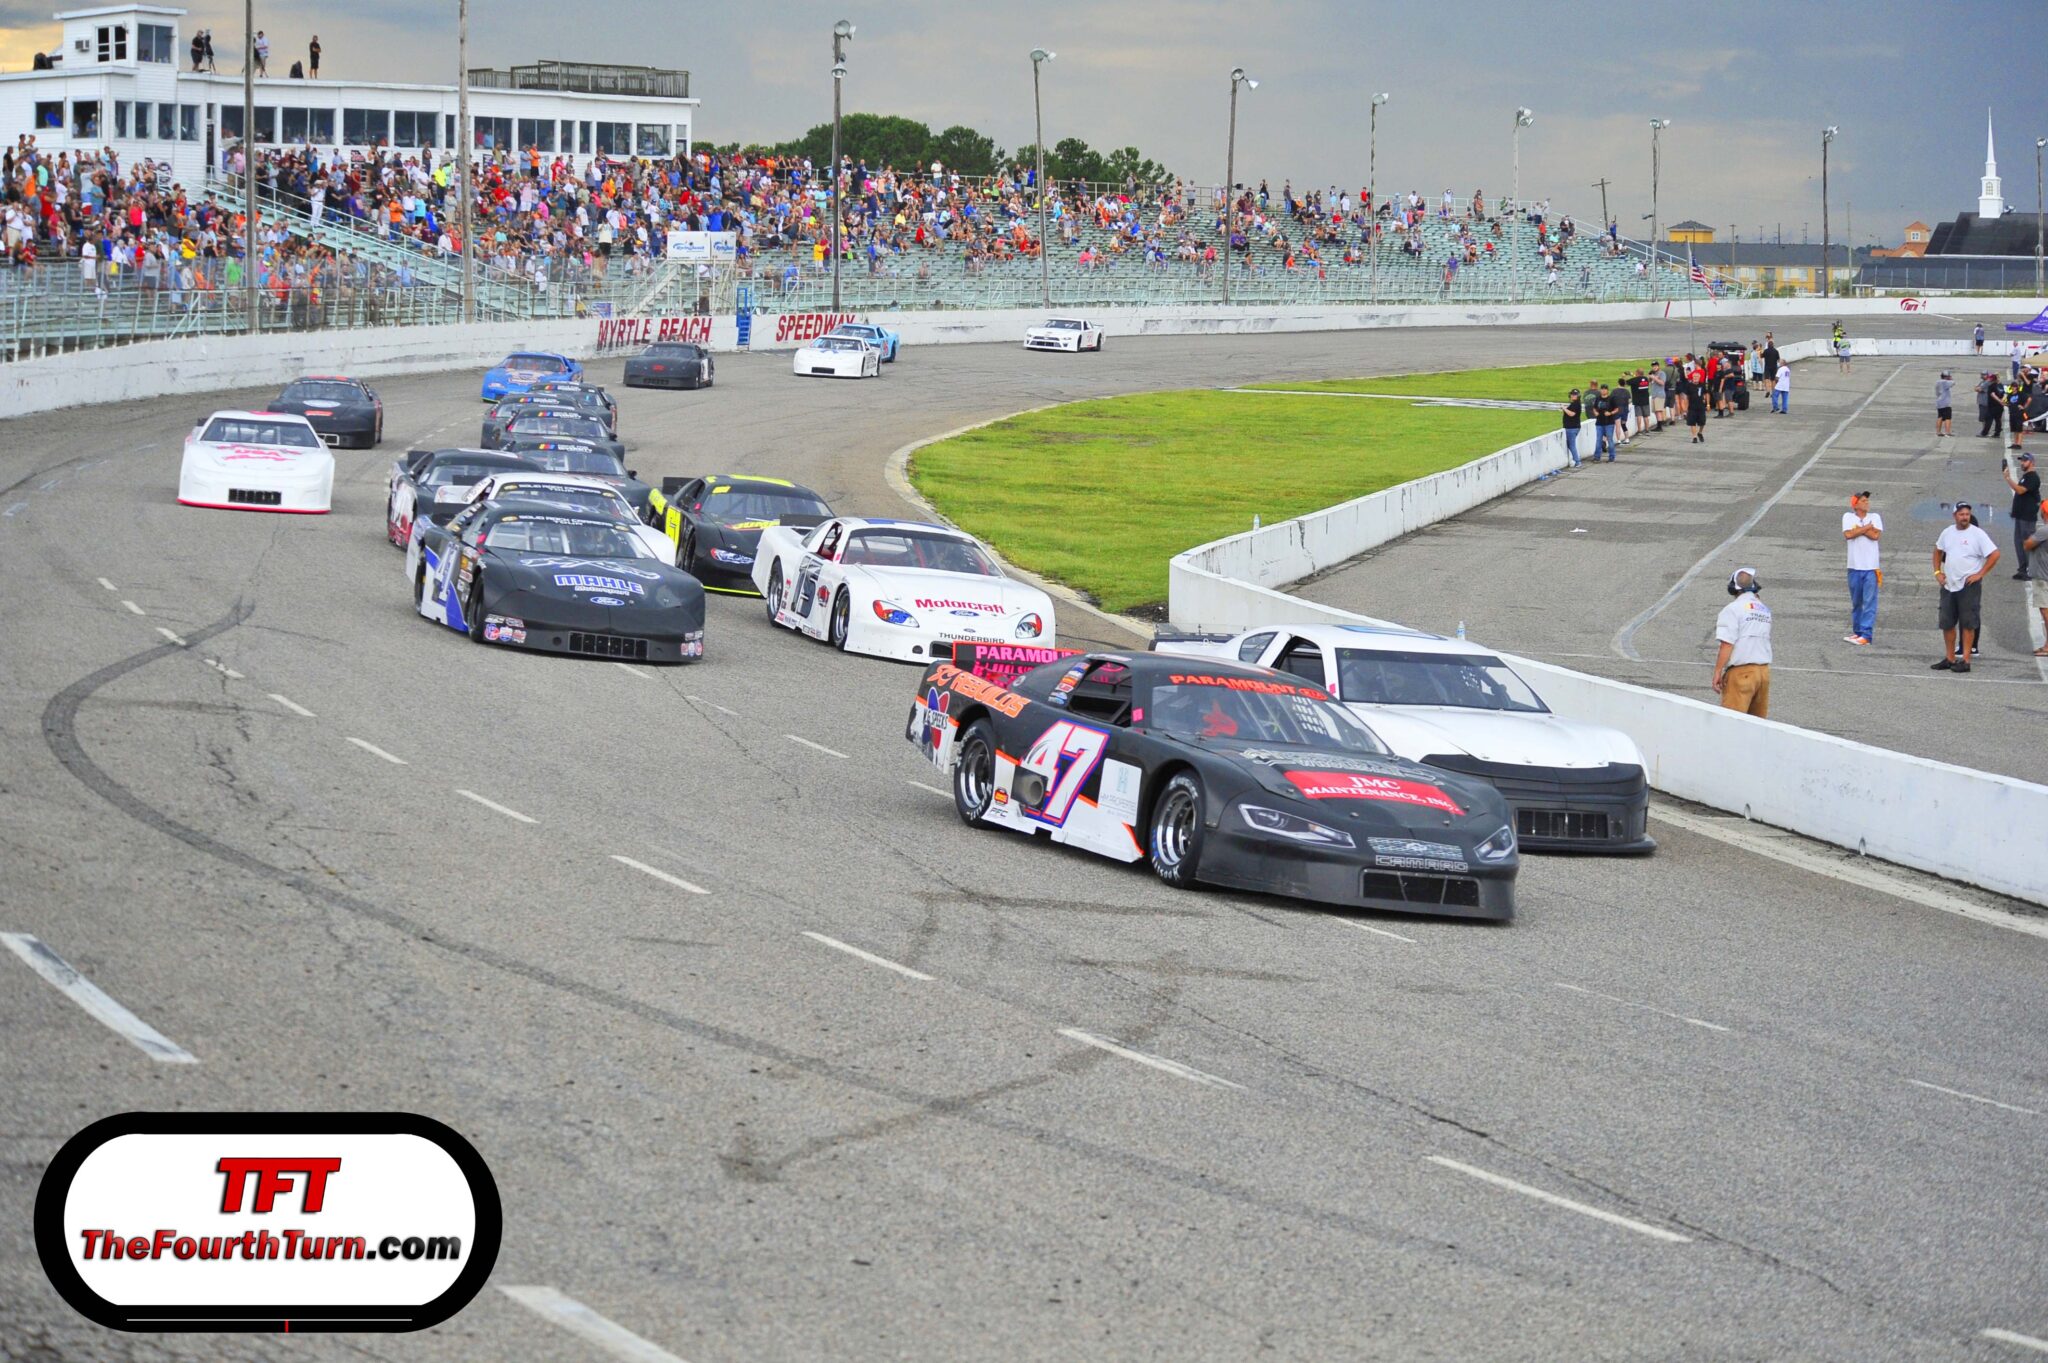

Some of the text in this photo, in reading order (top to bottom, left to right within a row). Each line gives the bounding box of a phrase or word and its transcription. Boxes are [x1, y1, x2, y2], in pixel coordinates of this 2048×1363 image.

[1903, 302, 1919, 311] Turn
[597, 319, 651, 351] MYRTLE
[658, 318, 713, 342] BEACH
[554, 574, 645, 595] MAHLE
[575, 585, 630, 597] Motorsport
[915, 598, 1005, 614] Motorcraft
[939, 632, 1005, 644] THUNDERBIRD
[1169, 674, 1296, 696] PARAMOUNT
[950, 671, 1032, 718] REBUILDS
[1023, 720, 1110, 825] 47
[1348, 776, 1401, 790] JMC
[1304, 787, 1427, 803] MAINTENANCE,
[1375, 854, 1468, 873] CAMARO
